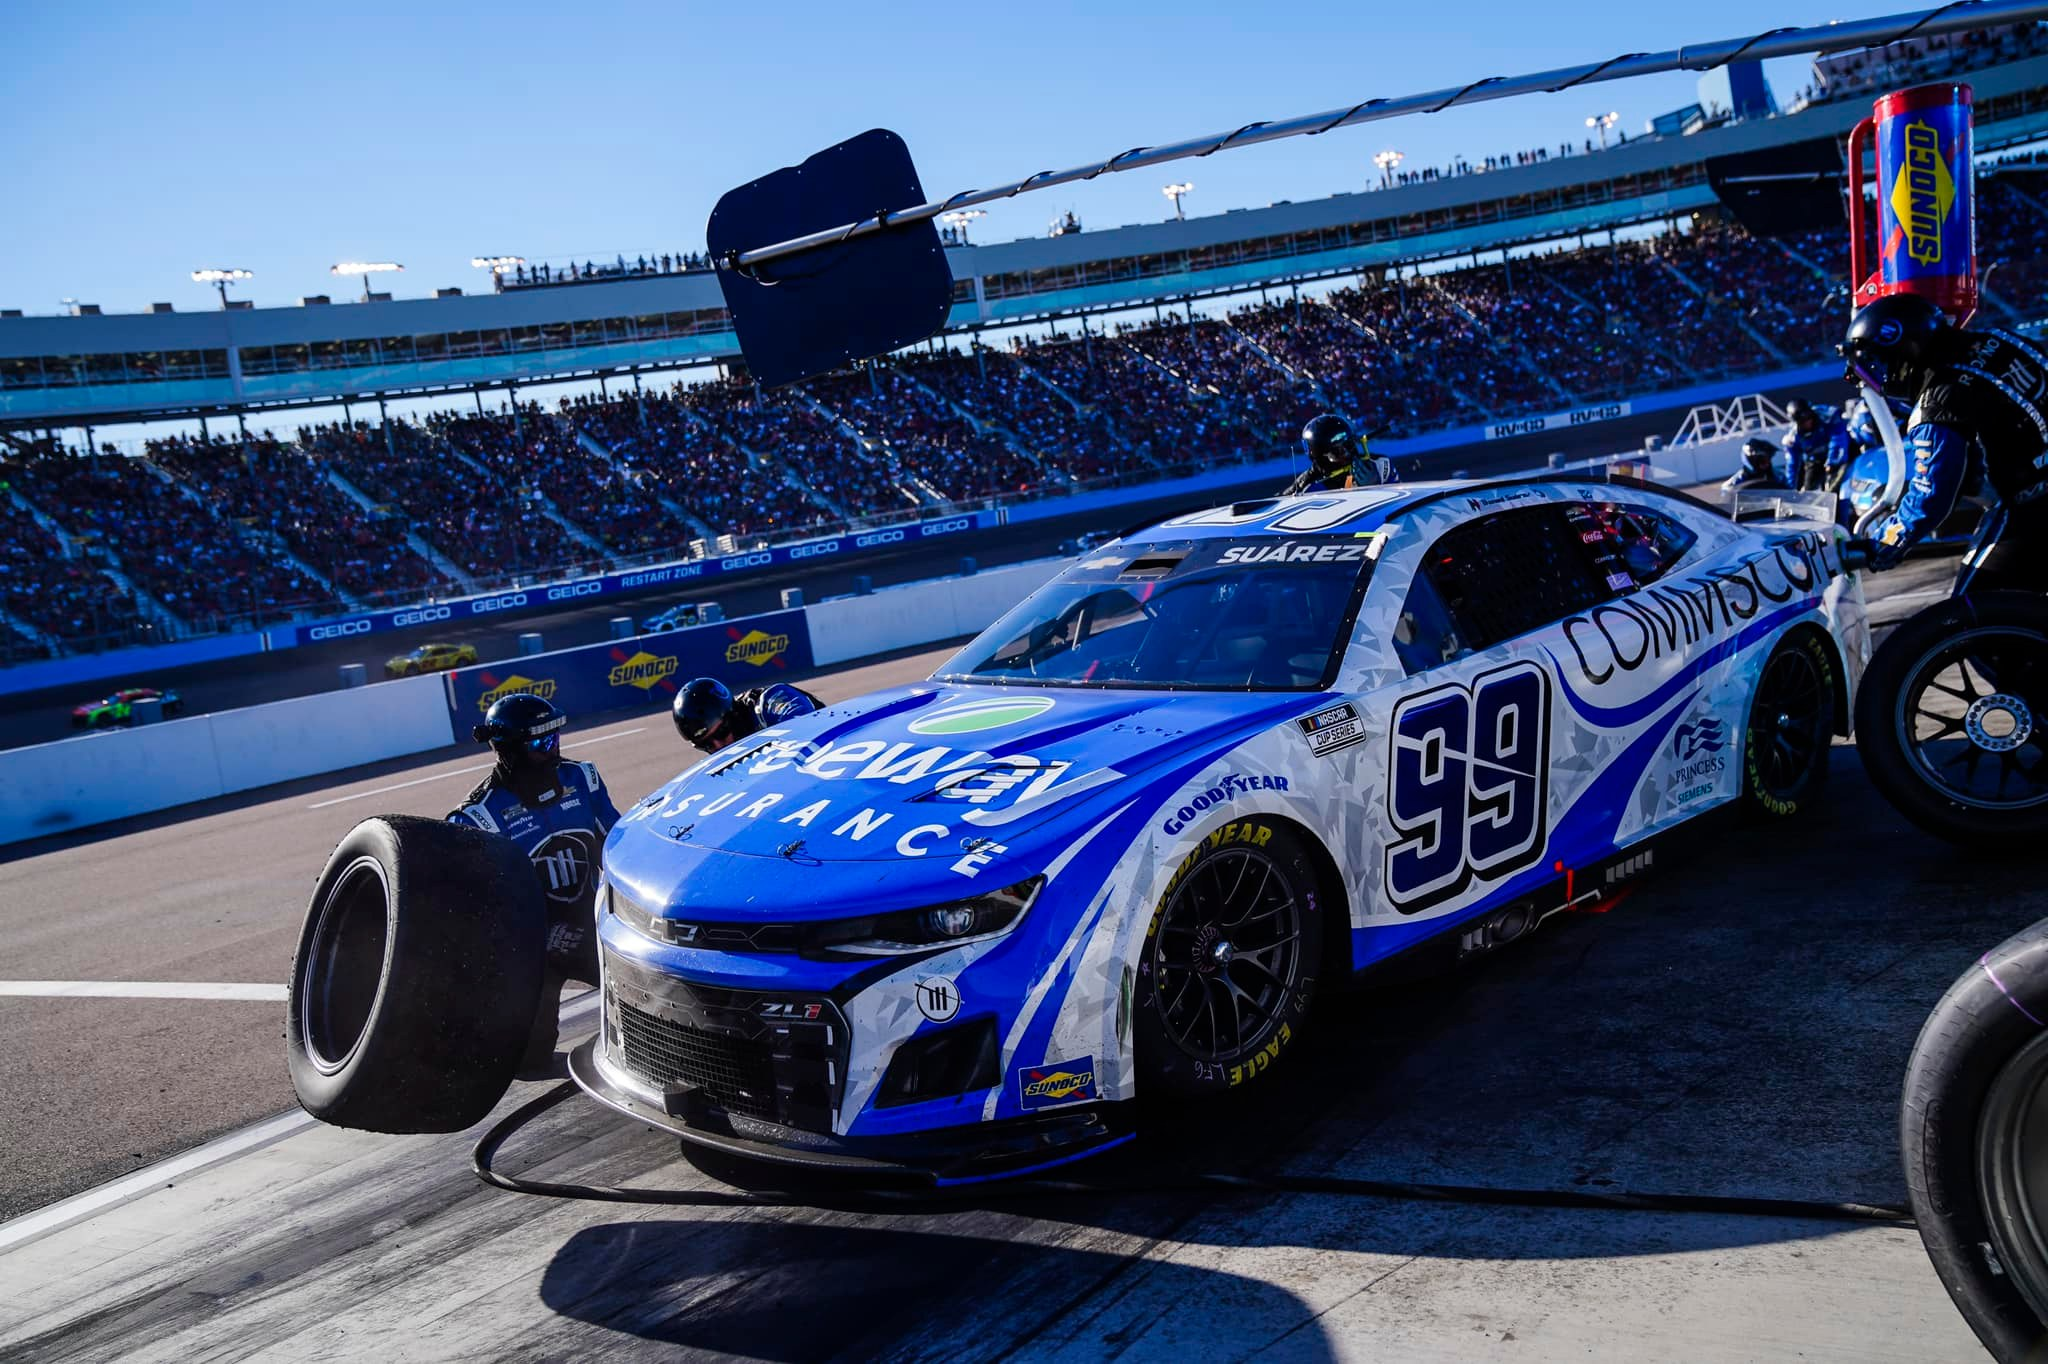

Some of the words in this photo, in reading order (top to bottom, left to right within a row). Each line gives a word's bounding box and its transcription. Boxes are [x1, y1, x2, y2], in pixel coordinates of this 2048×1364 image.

[1909, 128, 1939, 259] SUNOCO
[922, 518, 969, 536] GEICO
[790, 540, 839, 559] GEICO
[857, 530, 905, 548] GEICO
[722, 552, 772, 571] GEICO
[1216, 540, 1369, 565] SUÁREZ
[621, 569, 671, 588] RESTART
[674, 565, 703, 580] ZONE
[548, 581, 602, 601] GEICO
[472, 593, 528, 614] GEICO
[393, 605, 451, 627] GEICO
[310, 619, 372, 640] GEICO
[728, 636, 787, 662] SUNOCO
[611, 658, 677, 686] SUNOCO
[1318, 707, 1349, 728] NASCAR
[1316, 731, 1331, 745] CUP
[1332, 723, 1356, 740] SERIES
[1675, 756, 1725, 784] PRINCESS
[1384, 660, 1553, 915] 99
[1677, 782, 1713, 805] SIEMENS
[1163, 773, 1289, 836] GOODYEAR
[759, 1002, 822, 1020] ZL1
[1229, 1021, 1292, 1087] EAGLE
[1028, 1071, 1092, 1098] SUNOCO
